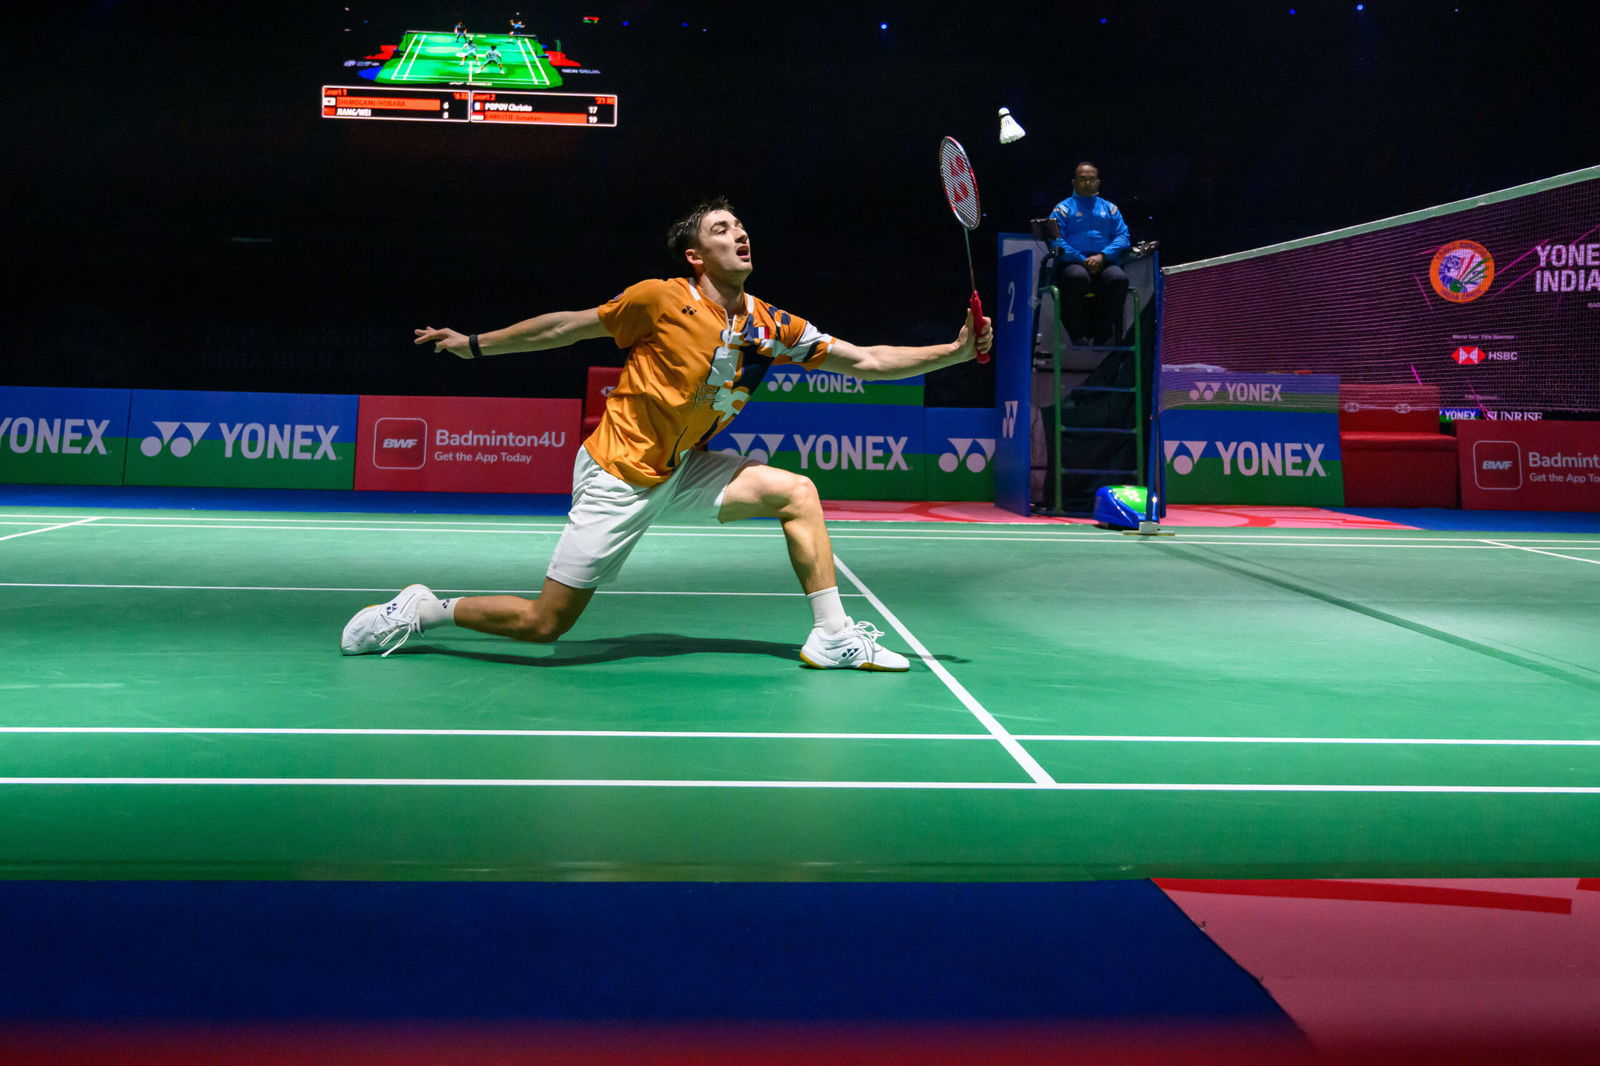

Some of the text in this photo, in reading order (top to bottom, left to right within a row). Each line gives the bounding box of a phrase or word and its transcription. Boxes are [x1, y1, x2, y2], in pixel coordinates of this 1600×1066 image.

[485, 102, 508, 111] POPOV
[588, 106, 598, 114] 17
[588, 115, 598, 124] 19
[1535, 244, 1600, 267] YONE
[1535, 269, 1600, 292] INDIA
[1007, 281, 1015, 322] 2
[1488, 351, 1518, 361] HSBC
[806, 373, 865, 394] YONEX
[1226, 383, 1283, 403] YONEX
[1445, 411, 1477, 421] YONEX
[219, 422, 339, 461] YONEX
[383, 438, 418, 449] BWF
[435, 429, 566, 448] Badminton4U
[435, 451, 532, 465] Get the App Today
[793, 433, 909, 471] YONEX
[1215, 441, 1326, 478] YONEX
[1528, 451, 1600, 468] Badmint
[1482, 460, 1513, 470] BWF
[1530, 473, 1547, 482] Get
[1549, 473, 1564, 482] the
[1566, 473, 1586, 484] App
